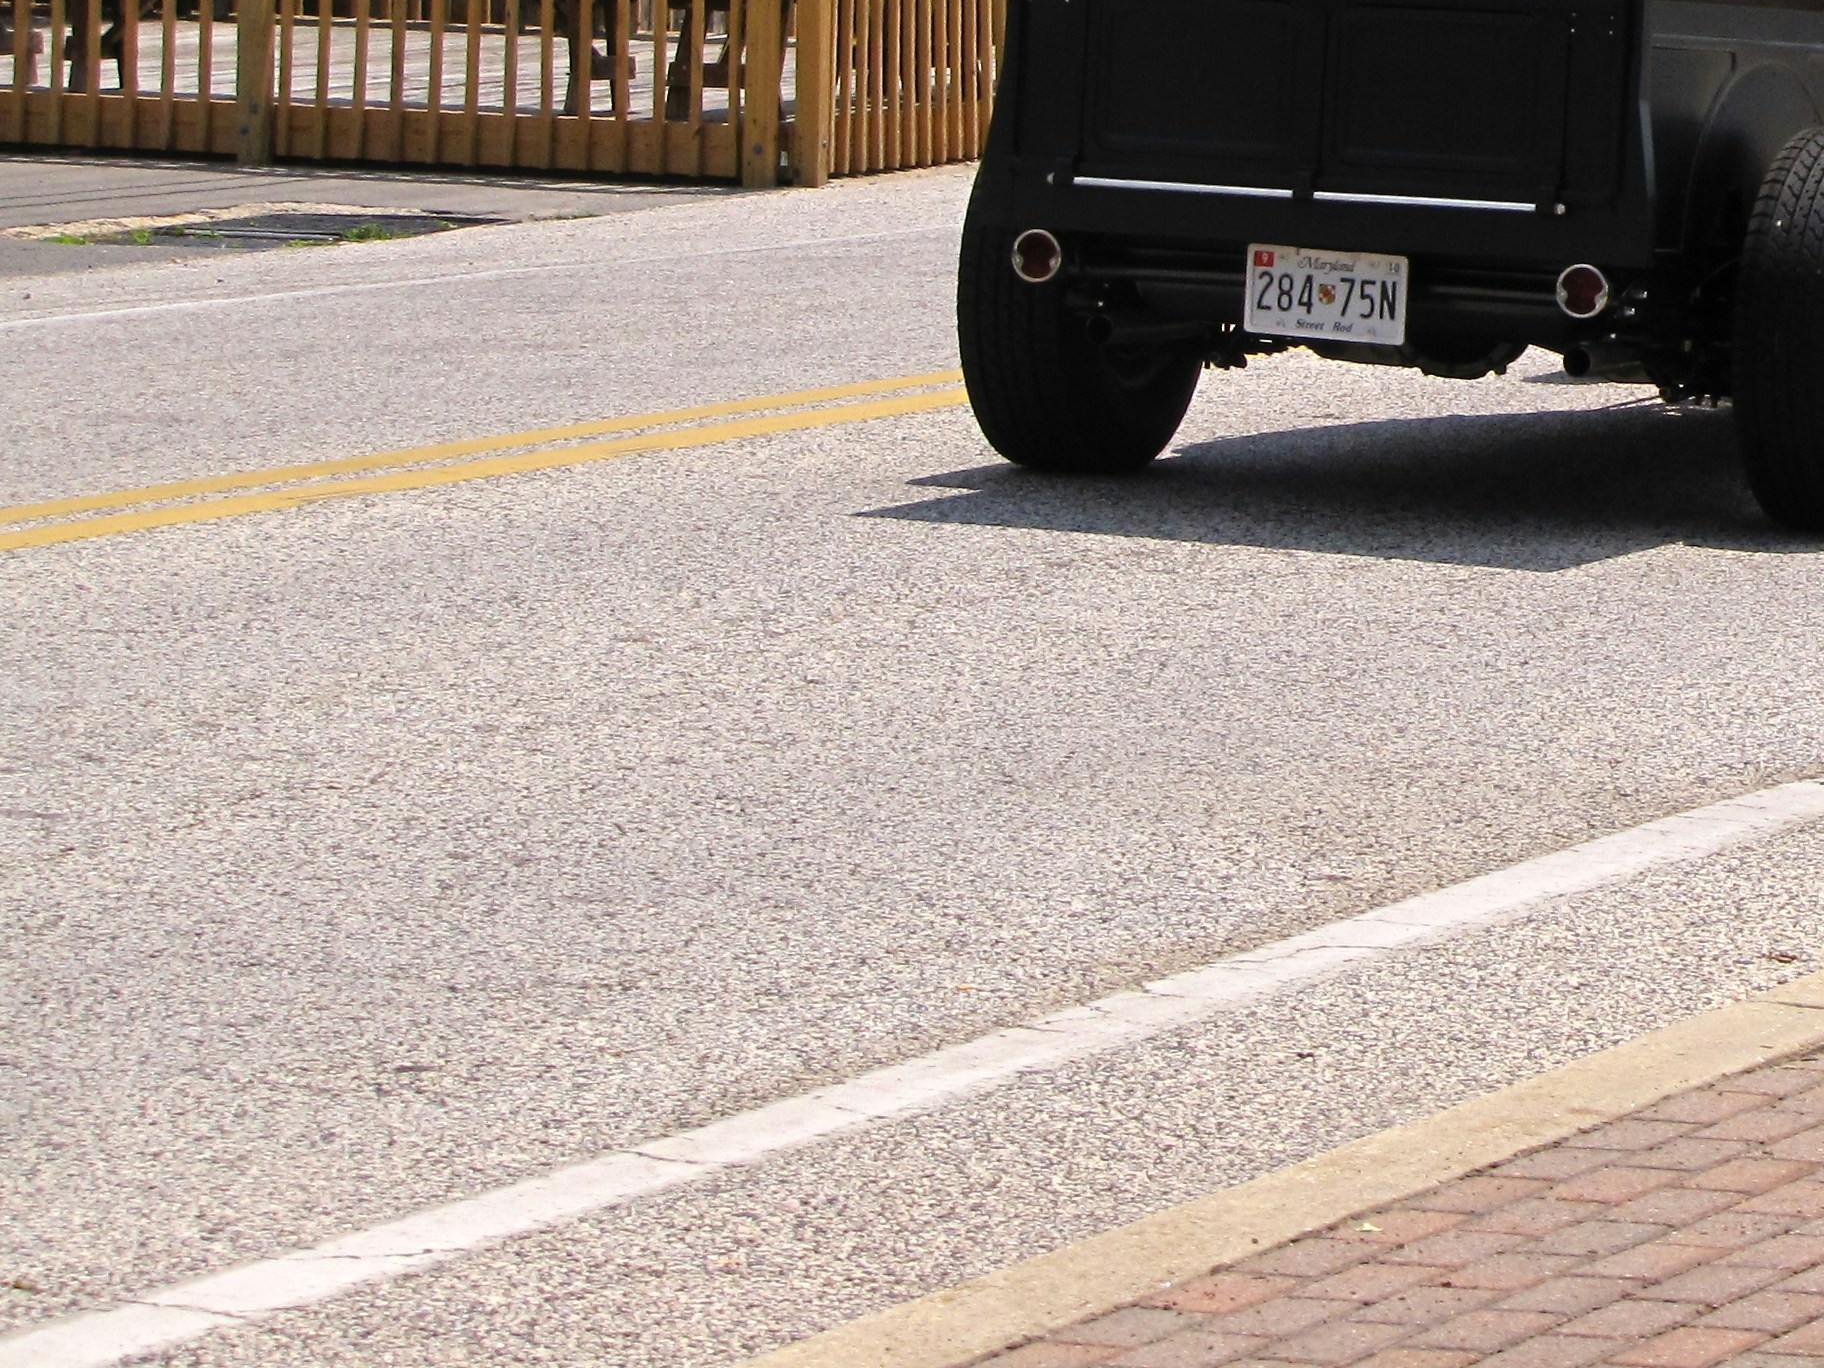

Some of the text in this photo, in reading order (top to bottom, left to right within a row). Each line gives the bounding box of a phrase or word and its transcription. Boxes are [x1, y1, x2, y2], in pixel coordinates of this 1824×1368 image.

[1297, 256, 1356, 275] Maryland
[1256, 270, 1397, 321] 284 75N
[1296, 319, 1354, 332] Street Rod
